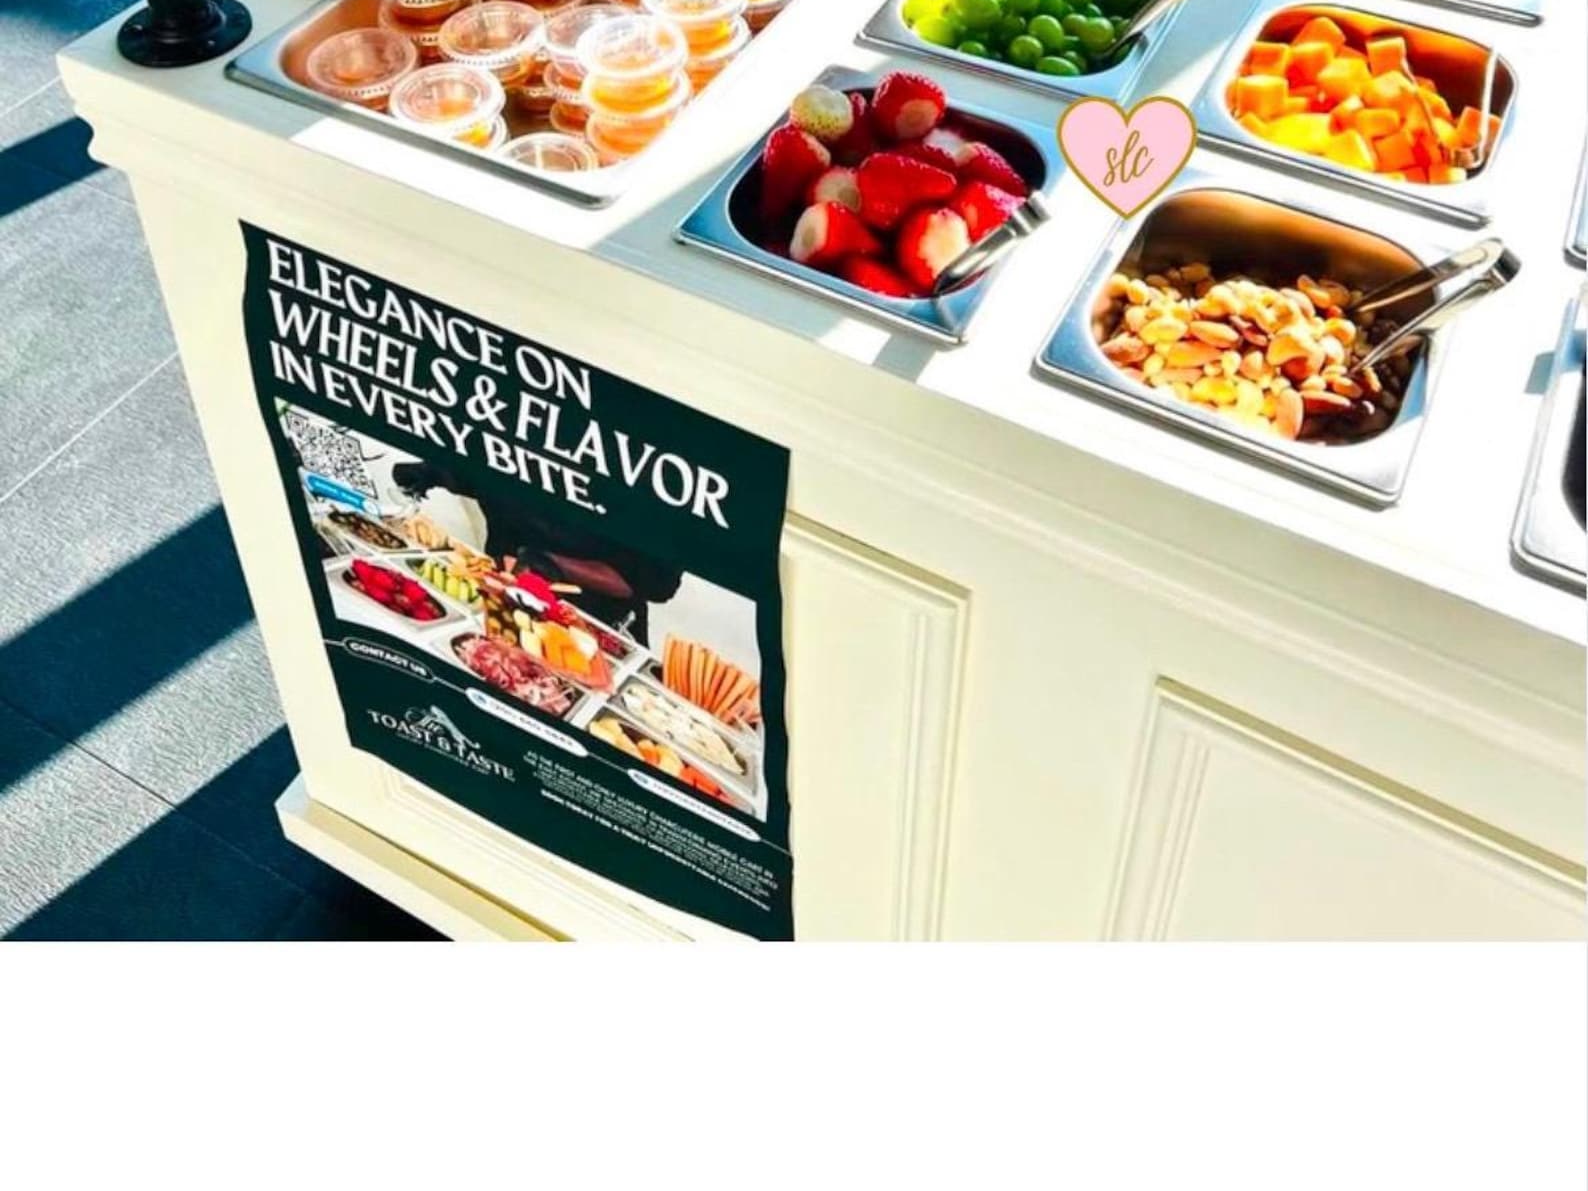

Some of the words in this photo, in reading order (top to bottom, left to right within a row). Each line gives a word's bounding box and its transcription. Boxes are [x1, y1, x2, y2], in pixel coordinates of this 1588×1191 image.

[267, 239, 508, 374] ELEGANCE
[515, 344, 592, 410] ON
[268, 288, 459, 409] WHEELS
[466, 375, 506, 432] &
[517, 391, 730, 529] FLAVOR
[270, 341, 317, 394] IN
[321, 362, 473, 457] EVERY
[483, 435, 607, 515] BITE.
[350, 642, 408, 669] CONTACT
[366, 708, 432, 743] TOAST
[451, 740, 516, 783] TASTE
